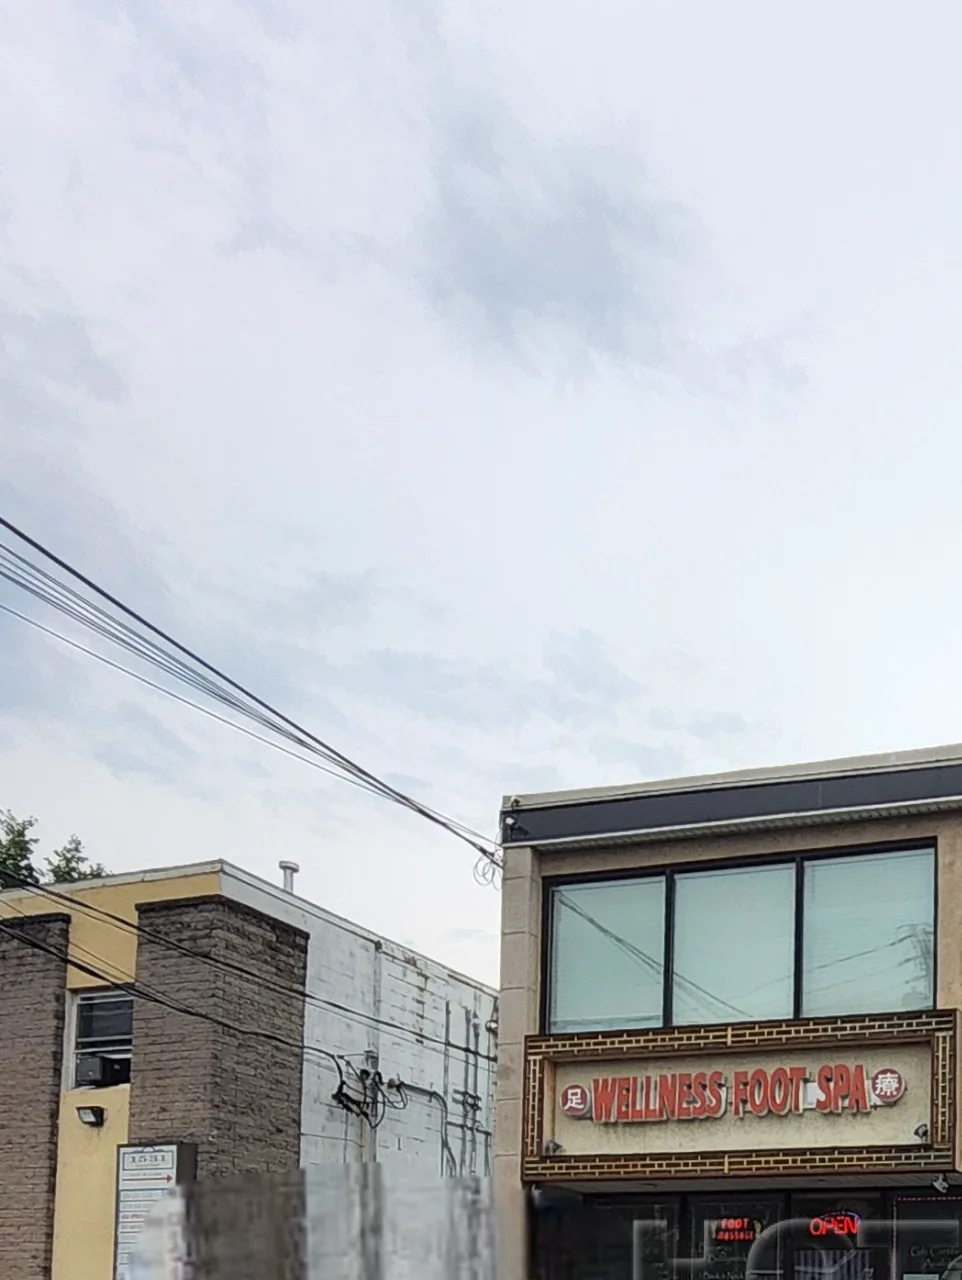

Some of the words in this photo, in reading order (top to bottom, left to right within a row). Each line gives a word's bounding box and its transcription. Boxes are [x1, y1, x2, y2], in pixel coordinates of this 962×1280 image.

[563, 1087, 585, 1111] 足
[592, 1071, 726, 1122] WELLNESS
[733, 1067, 807, 1117] FOOT
[816, 1064, 869, 1114] SPA
[130, 1154, 167, 1164] 1531
[720, 1218, 750, 1229] FOOT
[810, 1216, 858, 1235] OPEN
